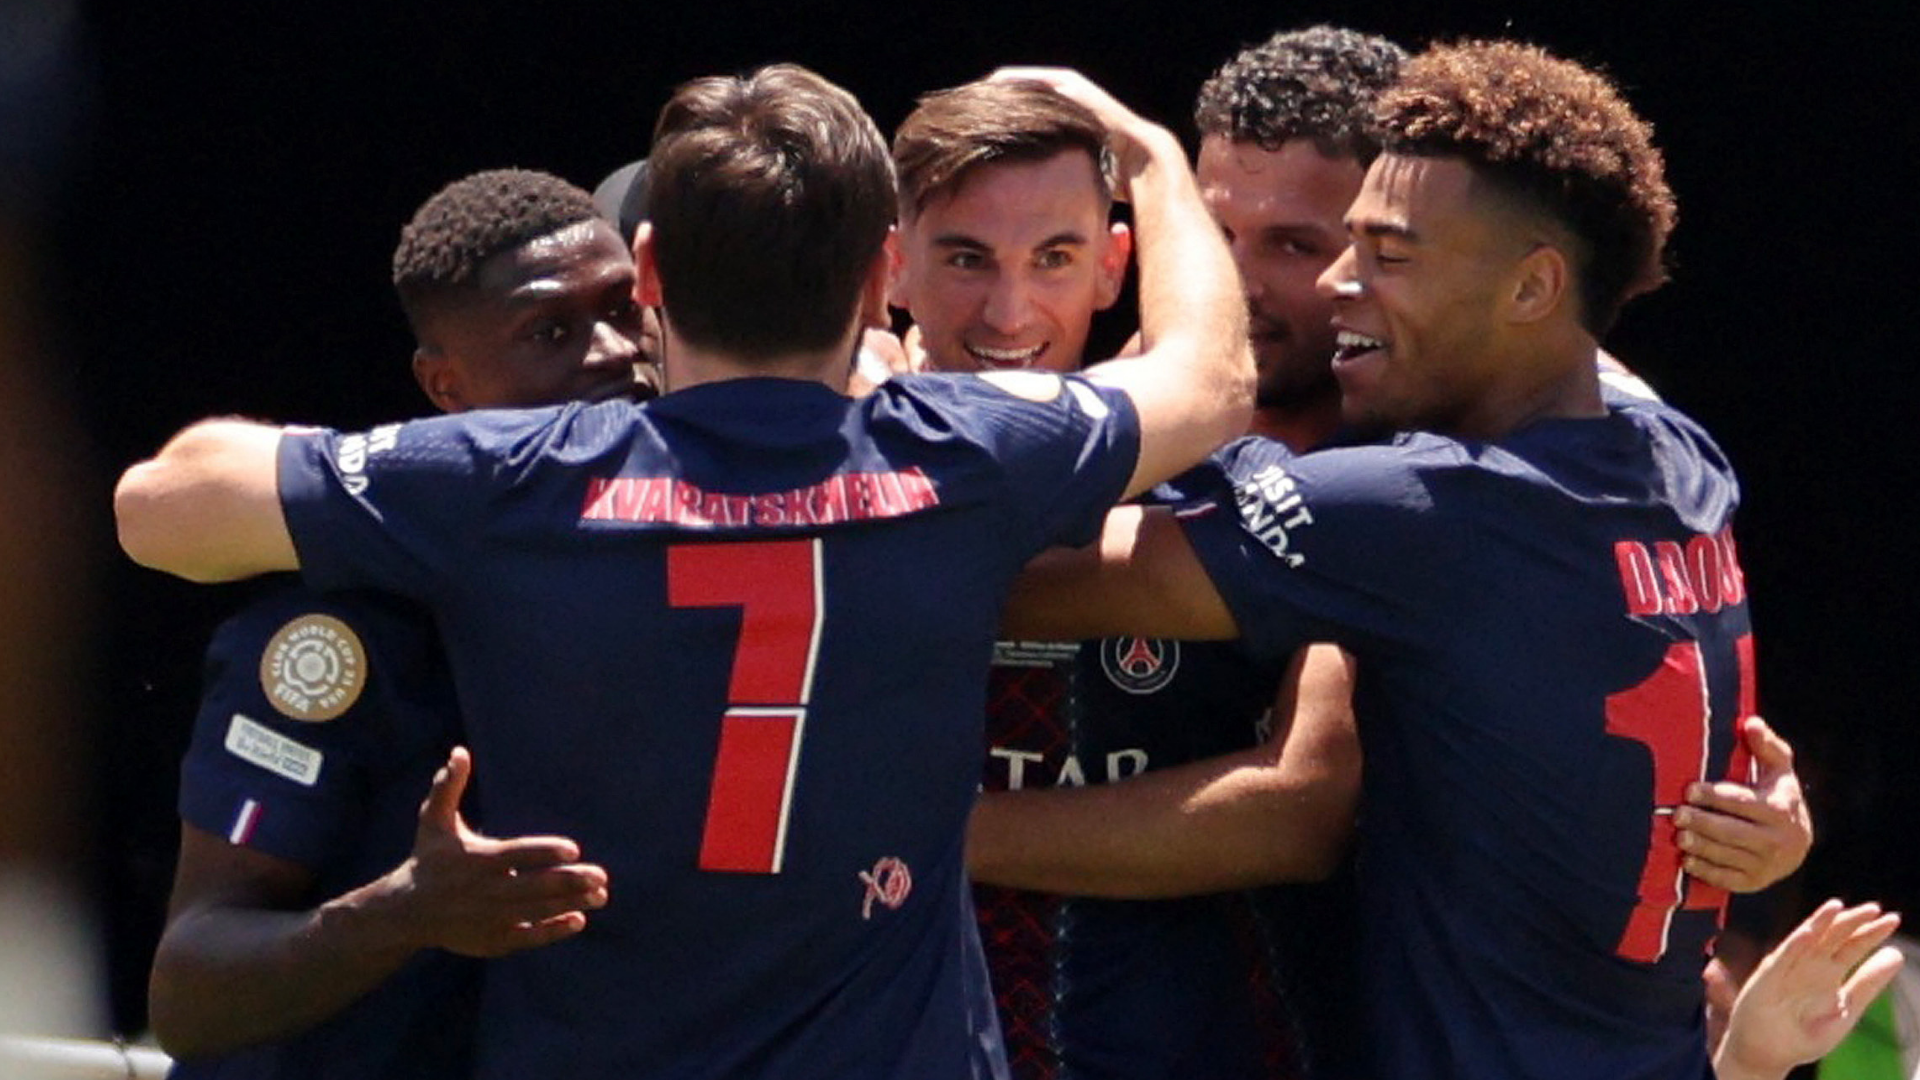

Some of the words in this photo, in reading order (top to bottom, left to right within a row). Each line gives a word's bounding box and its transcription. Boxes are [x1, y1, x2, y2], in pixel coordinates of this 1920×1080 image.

[288, 625, 337, 643] WORLD
[336, 639, 357, 665] CUP
[274, 683, 310, 713] FIFA
[667, 538, 824, 874] 7
[979, 746, 1149, 791] TAR
